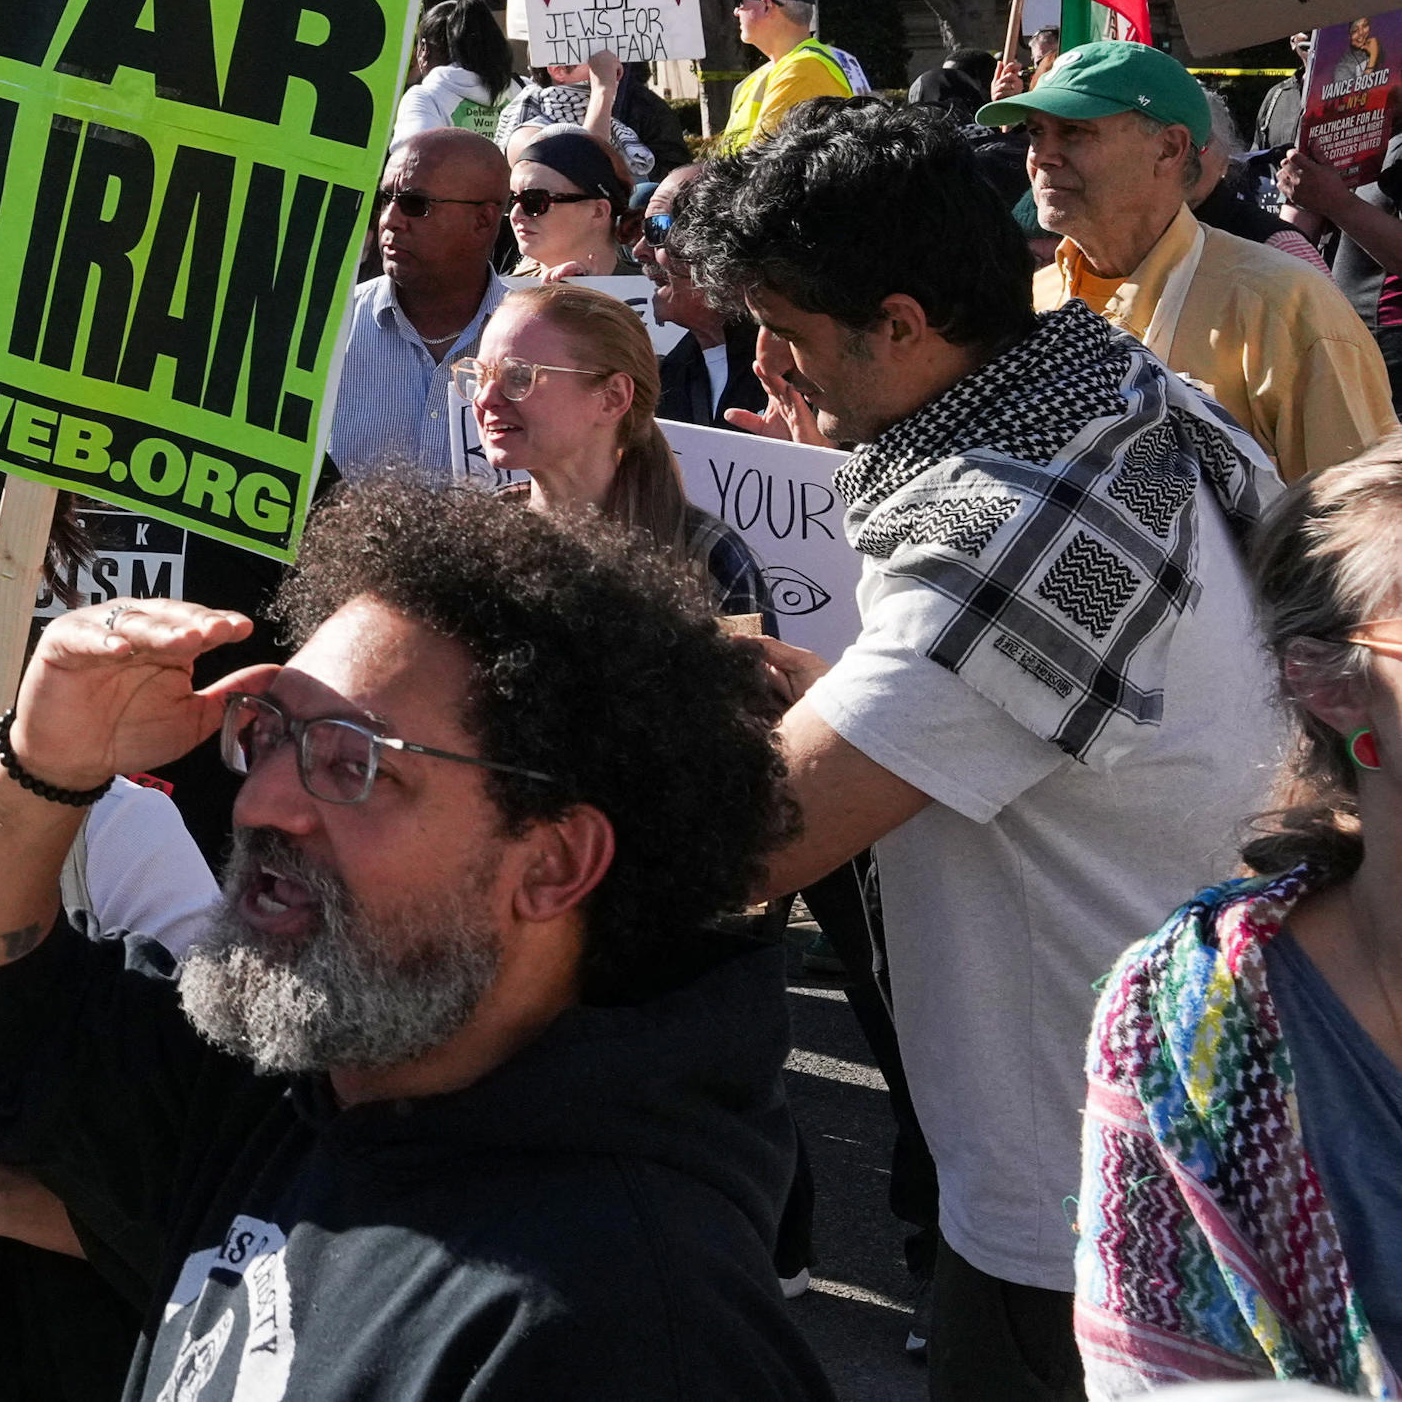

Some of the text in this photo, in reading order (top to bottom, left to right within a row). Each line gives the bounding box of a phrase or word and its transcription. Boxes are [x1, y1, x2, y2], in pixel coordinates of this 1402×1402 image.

[546, 7, 665, 40] JEWS FOR
[1321, 68, 1390, 100] VANCE BOSTIC
[1309, 108, 1385, 139] HEALTHCARE FOR ALL
[1366, 120, 1384, 134] RIGHT
[1329, 144, 1358, 160] CITIZENS
[1358, 137, 1382, 155] UNITED
[7, 111, 365, 445] IRAN!
[709, 459, 835, 541] YOUR
